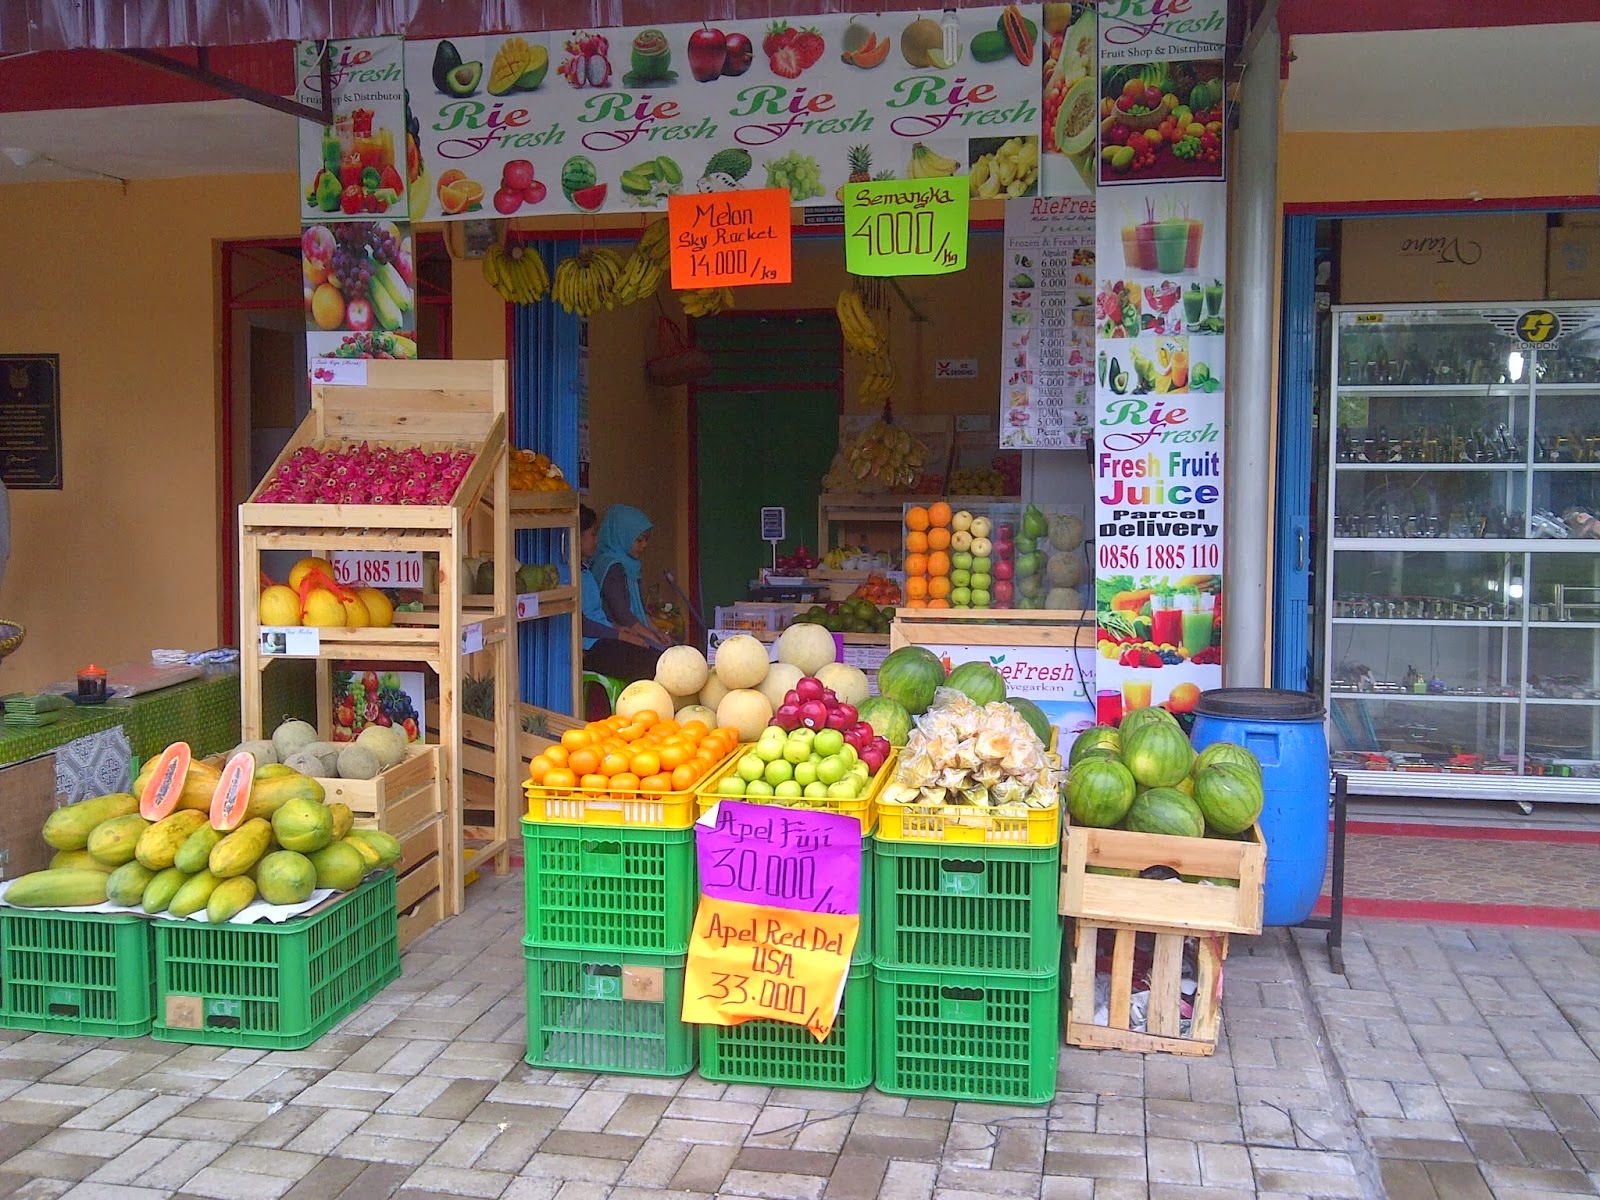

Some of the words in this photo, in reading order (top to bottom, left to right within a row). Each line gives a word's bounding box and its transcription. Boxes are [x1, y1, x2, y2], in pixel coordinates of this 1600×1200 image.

[300, 45, 372, 70] Rie
[1101, 49, 1125, 58] Fruit
[1128, 47, 1153, 58] Shop
[1155, 46, 1166, 55] &
[1169, 43, 1225, 54] Distributor
[354, 91, 401, 102] Distributor
[729, 84, 837, 117] Rie
[886, 75, 998, 108] Rie
[432, 100, 531, 131] Rie
[578, 92, 681, 123] Rie
[890, 100, 1037, 137] Fresh
[581, 117, 718, 151] Fresh
[733, 109, 875, 145] Fresh
[437, 122, 566, 159] Fresh
[852, 187, 954, 209] Semangka
[692, 202, 753, 228] Melon
[679, 231, 708, 251] Sky
[1009, 239, 1039, 247] Frozen
[1042, 238, 1049, 246] &
[1054, 237, 1078, 246] Fresh
[1041, 269, 1066, 278] SIRSAK
[1040, 309, 1066, 318] MELON
[1037, 398, 1063, 407] 6.000
[1100, 399, 1189, 426] Rie
[1037, 418, 1063, 426] 5.000
[1037, 428, 1061, 436] Pear
[1036, 437, 1062, 446] 6.000
[1103, 422, 1219, 451] Fresh
[1100, 452, 1160, 478] Fresh
[1169, 451, 1219, 477] Fruit
[1100, 480, 1219, 505] Juice
[1113, 509, 1205, 520] Parcel
[1100, 520, 1218, 537] Delivery
[1100, 545, 1139, 569] 0856
[1146, 545, 1185, 569] 1885
[1192, 544, 1218, 568] 110
[329, 560, 350, 581] 56
[356, 560, 390, 582] 1885
[396, 560, 420, 582] 110
[708, 810, 774, 844] Apel
[780, 818, 834, 853] Fuji
[704, 913, 757, 947] Apel
[763, 920, 805, 949] Red
[812, 927, 843, 956] Del
[752, 947, 794, 978] USA
